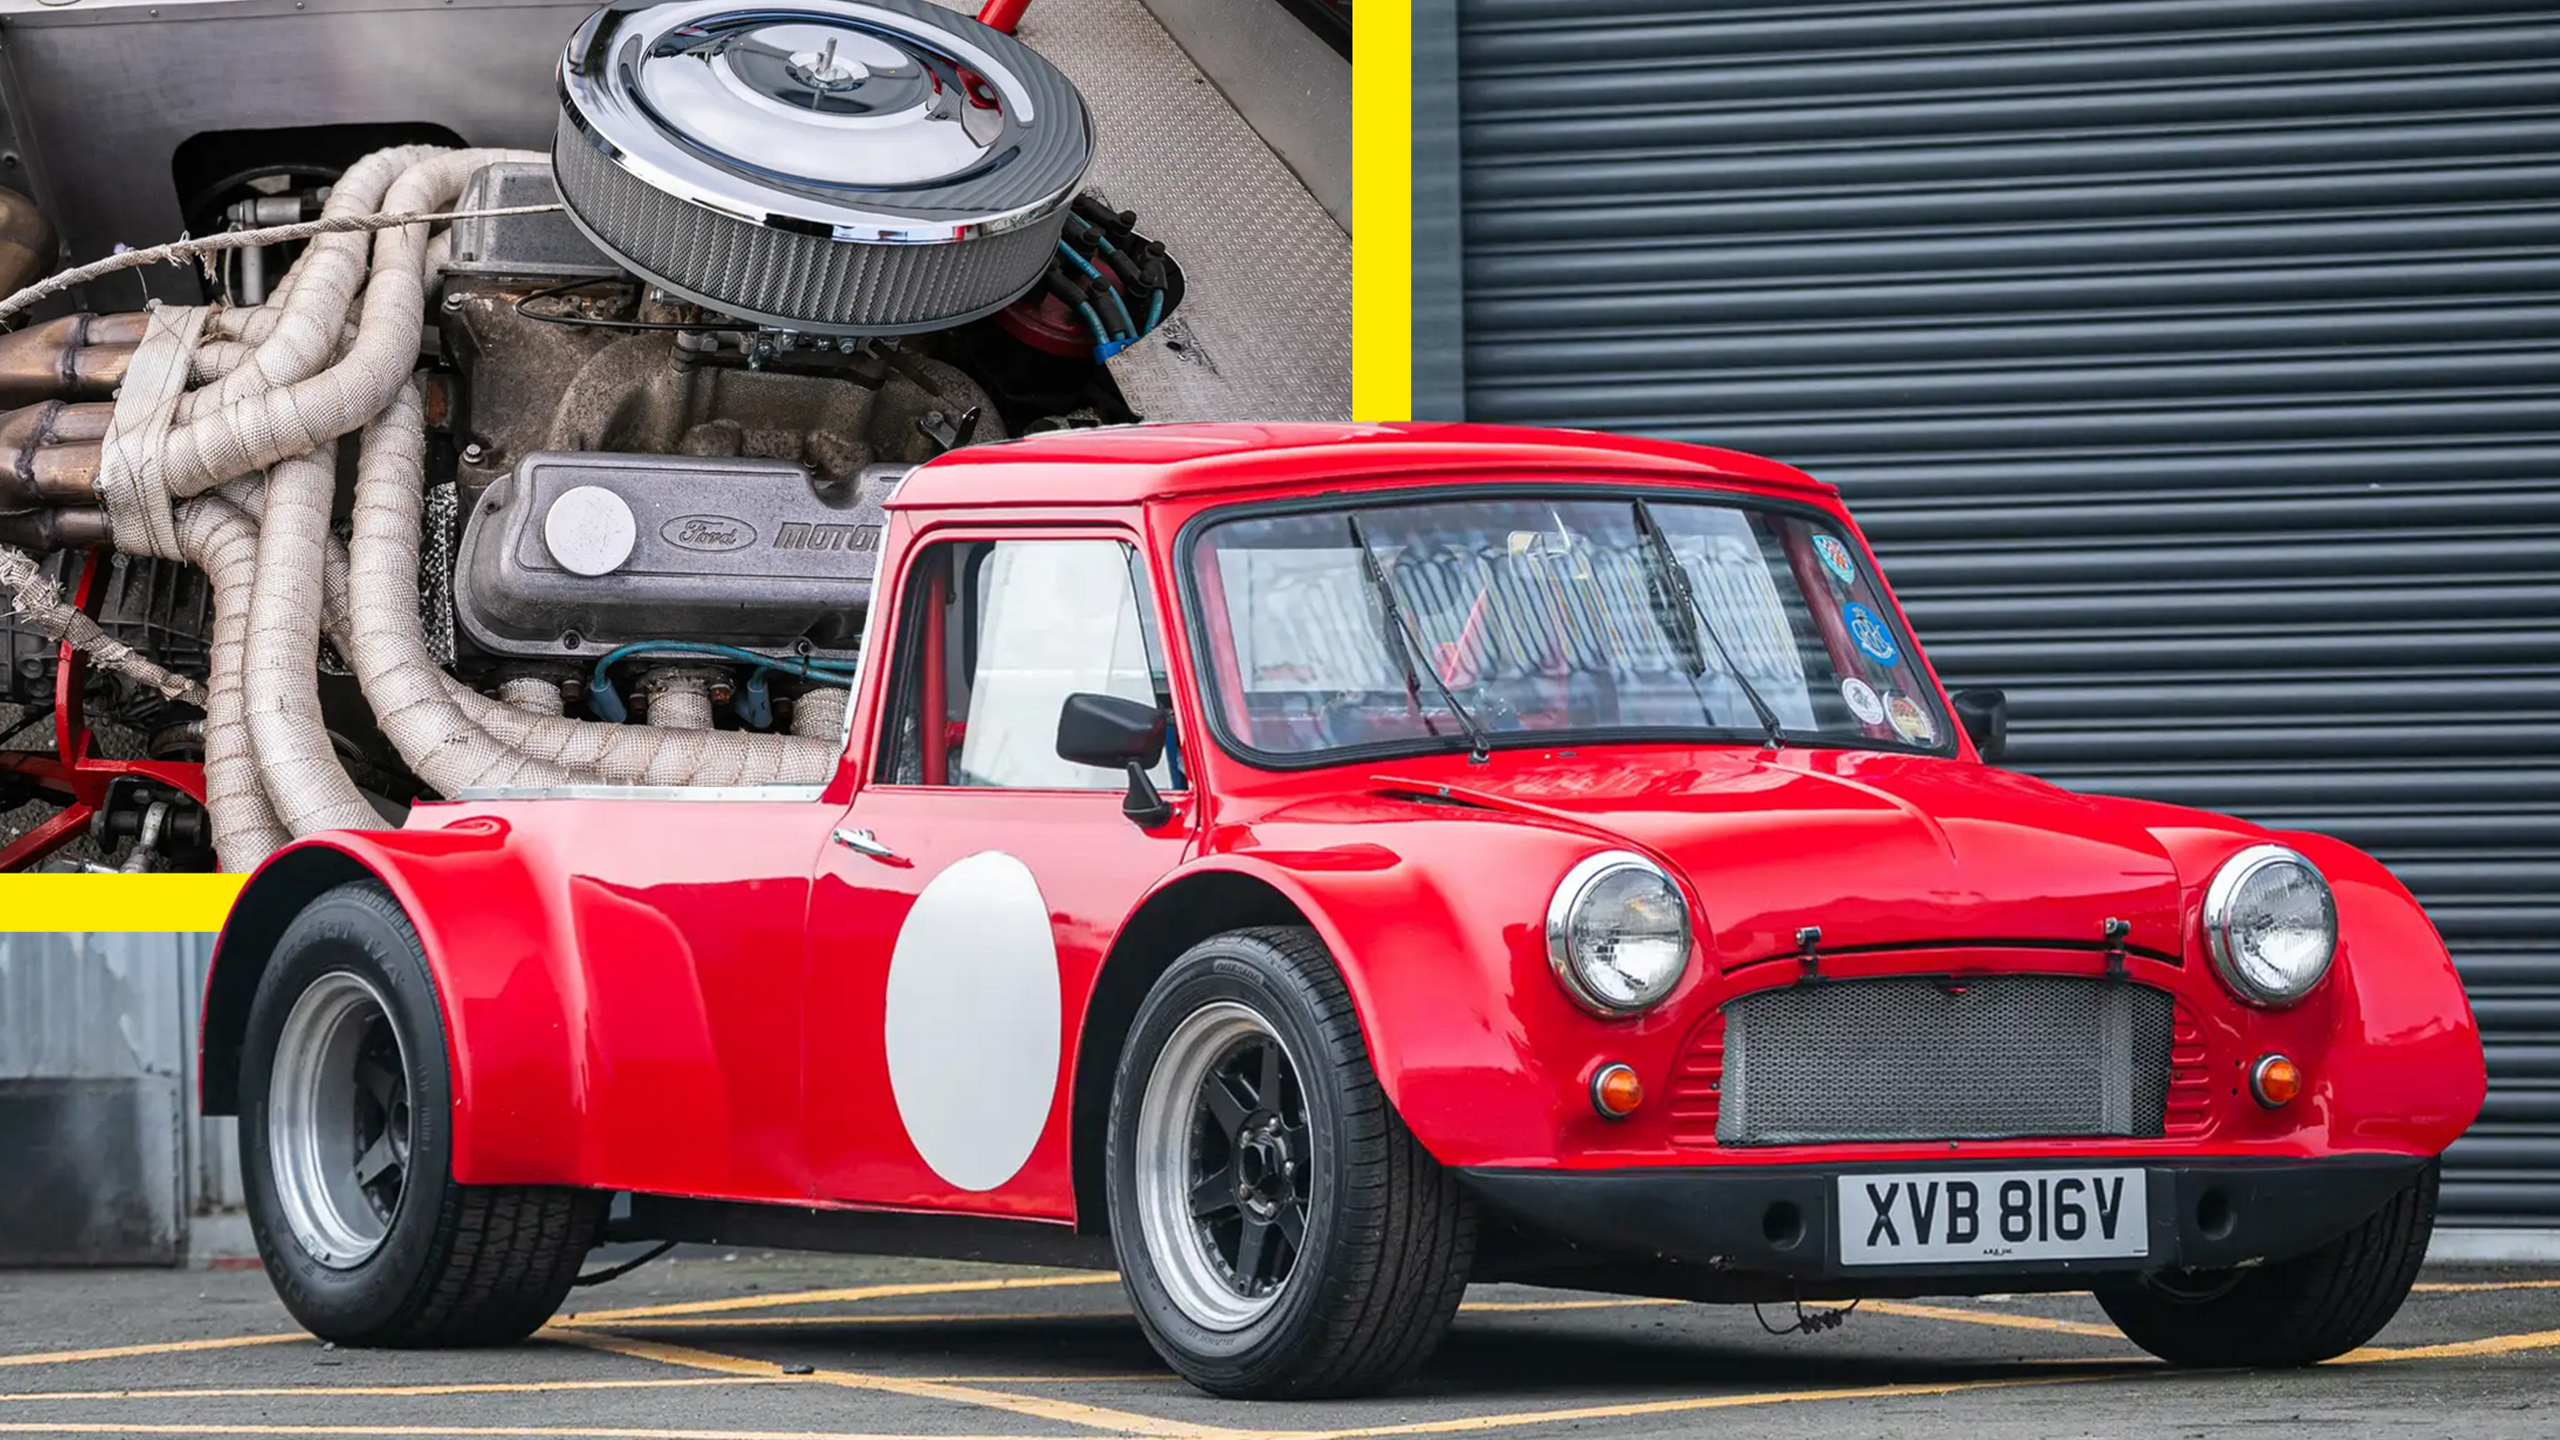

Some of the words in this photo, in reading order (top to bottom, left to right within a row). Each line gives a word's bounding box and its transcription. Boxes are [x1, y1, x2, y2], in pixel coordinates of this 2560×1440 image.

[679, 519, 738, 546] Ford
[1865, 1181, 1979, 1247] XVB
[2000, 1176, 2125, 1242] 816V
